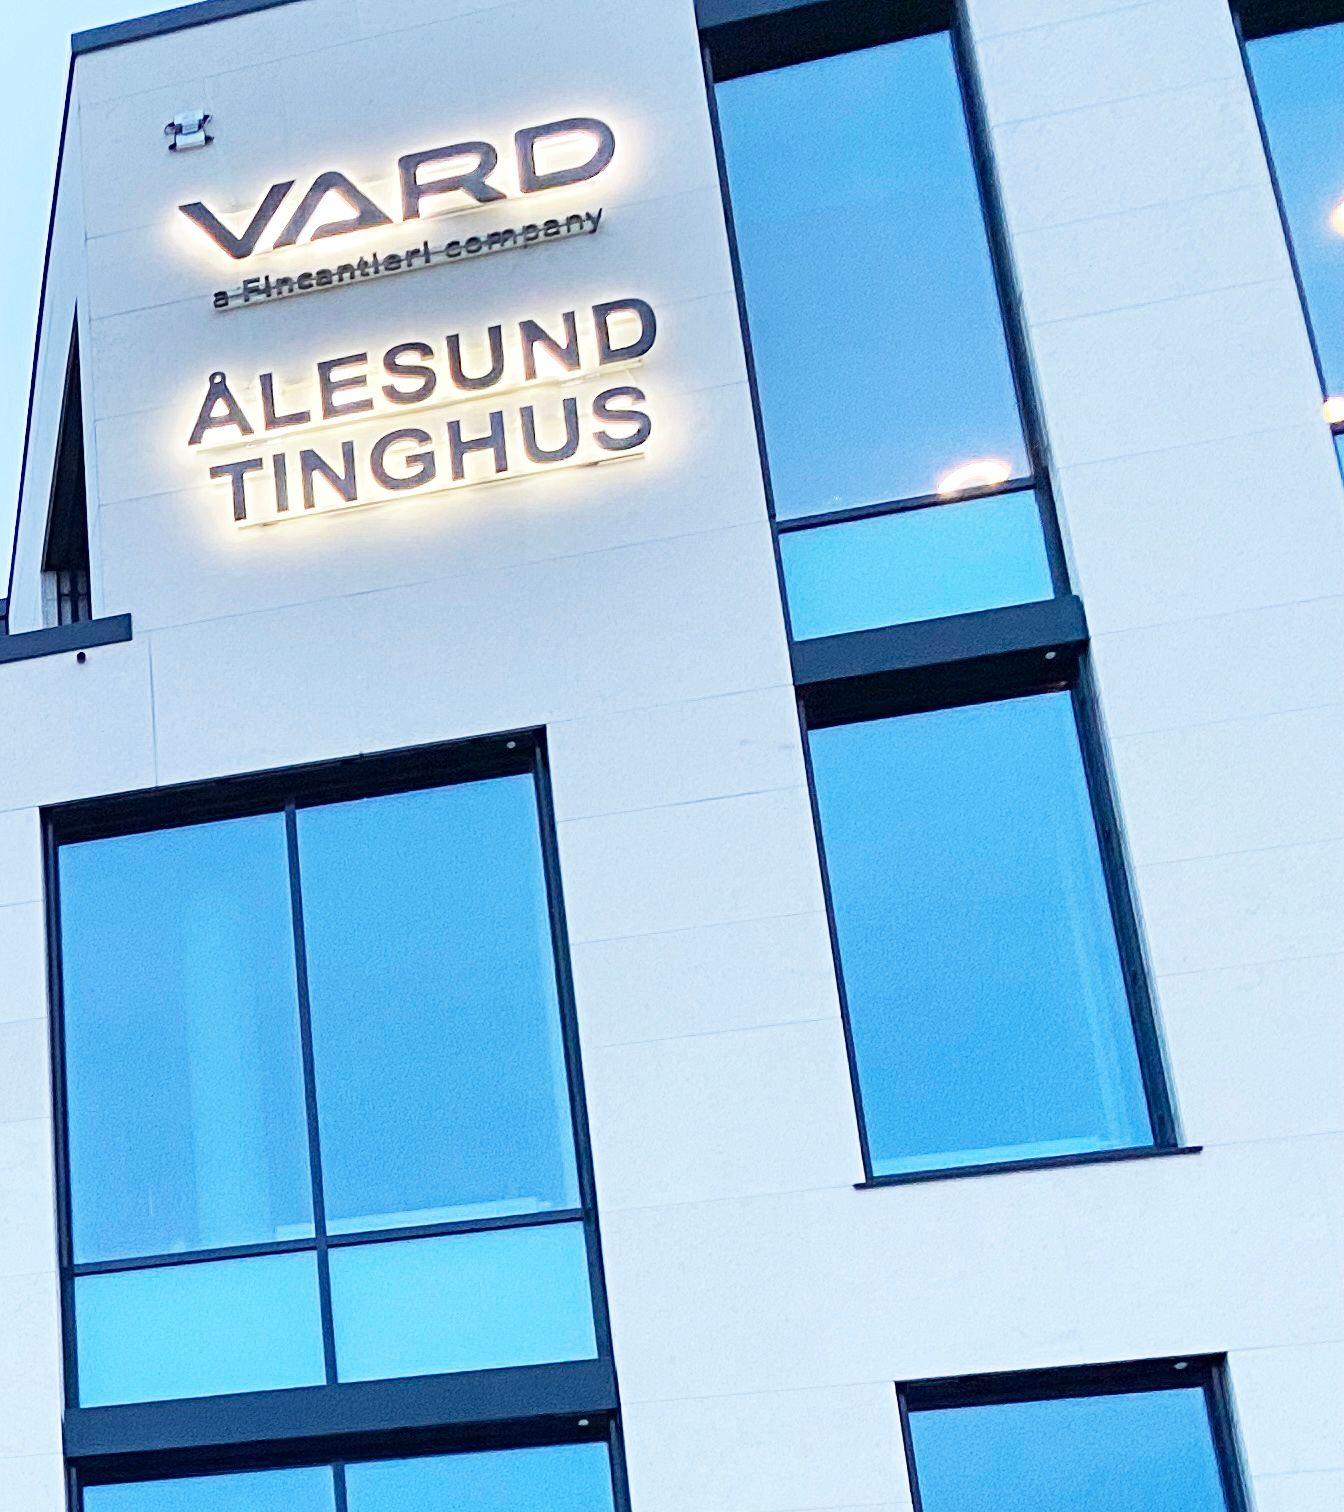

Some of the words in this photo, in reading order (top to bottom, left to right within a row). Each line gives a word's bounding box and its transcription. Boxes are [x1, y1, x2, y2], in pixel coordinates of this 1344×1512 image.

[178, 116, 616, 260] VARD
[212, 288, 230, 309] a
[242, 240, 431, 303] Fincantieri
[445, 207, 604, 258] company
[188, 298, 658, 446] ÅLESUND
[209, 386, 652, 522] TINGHUS
